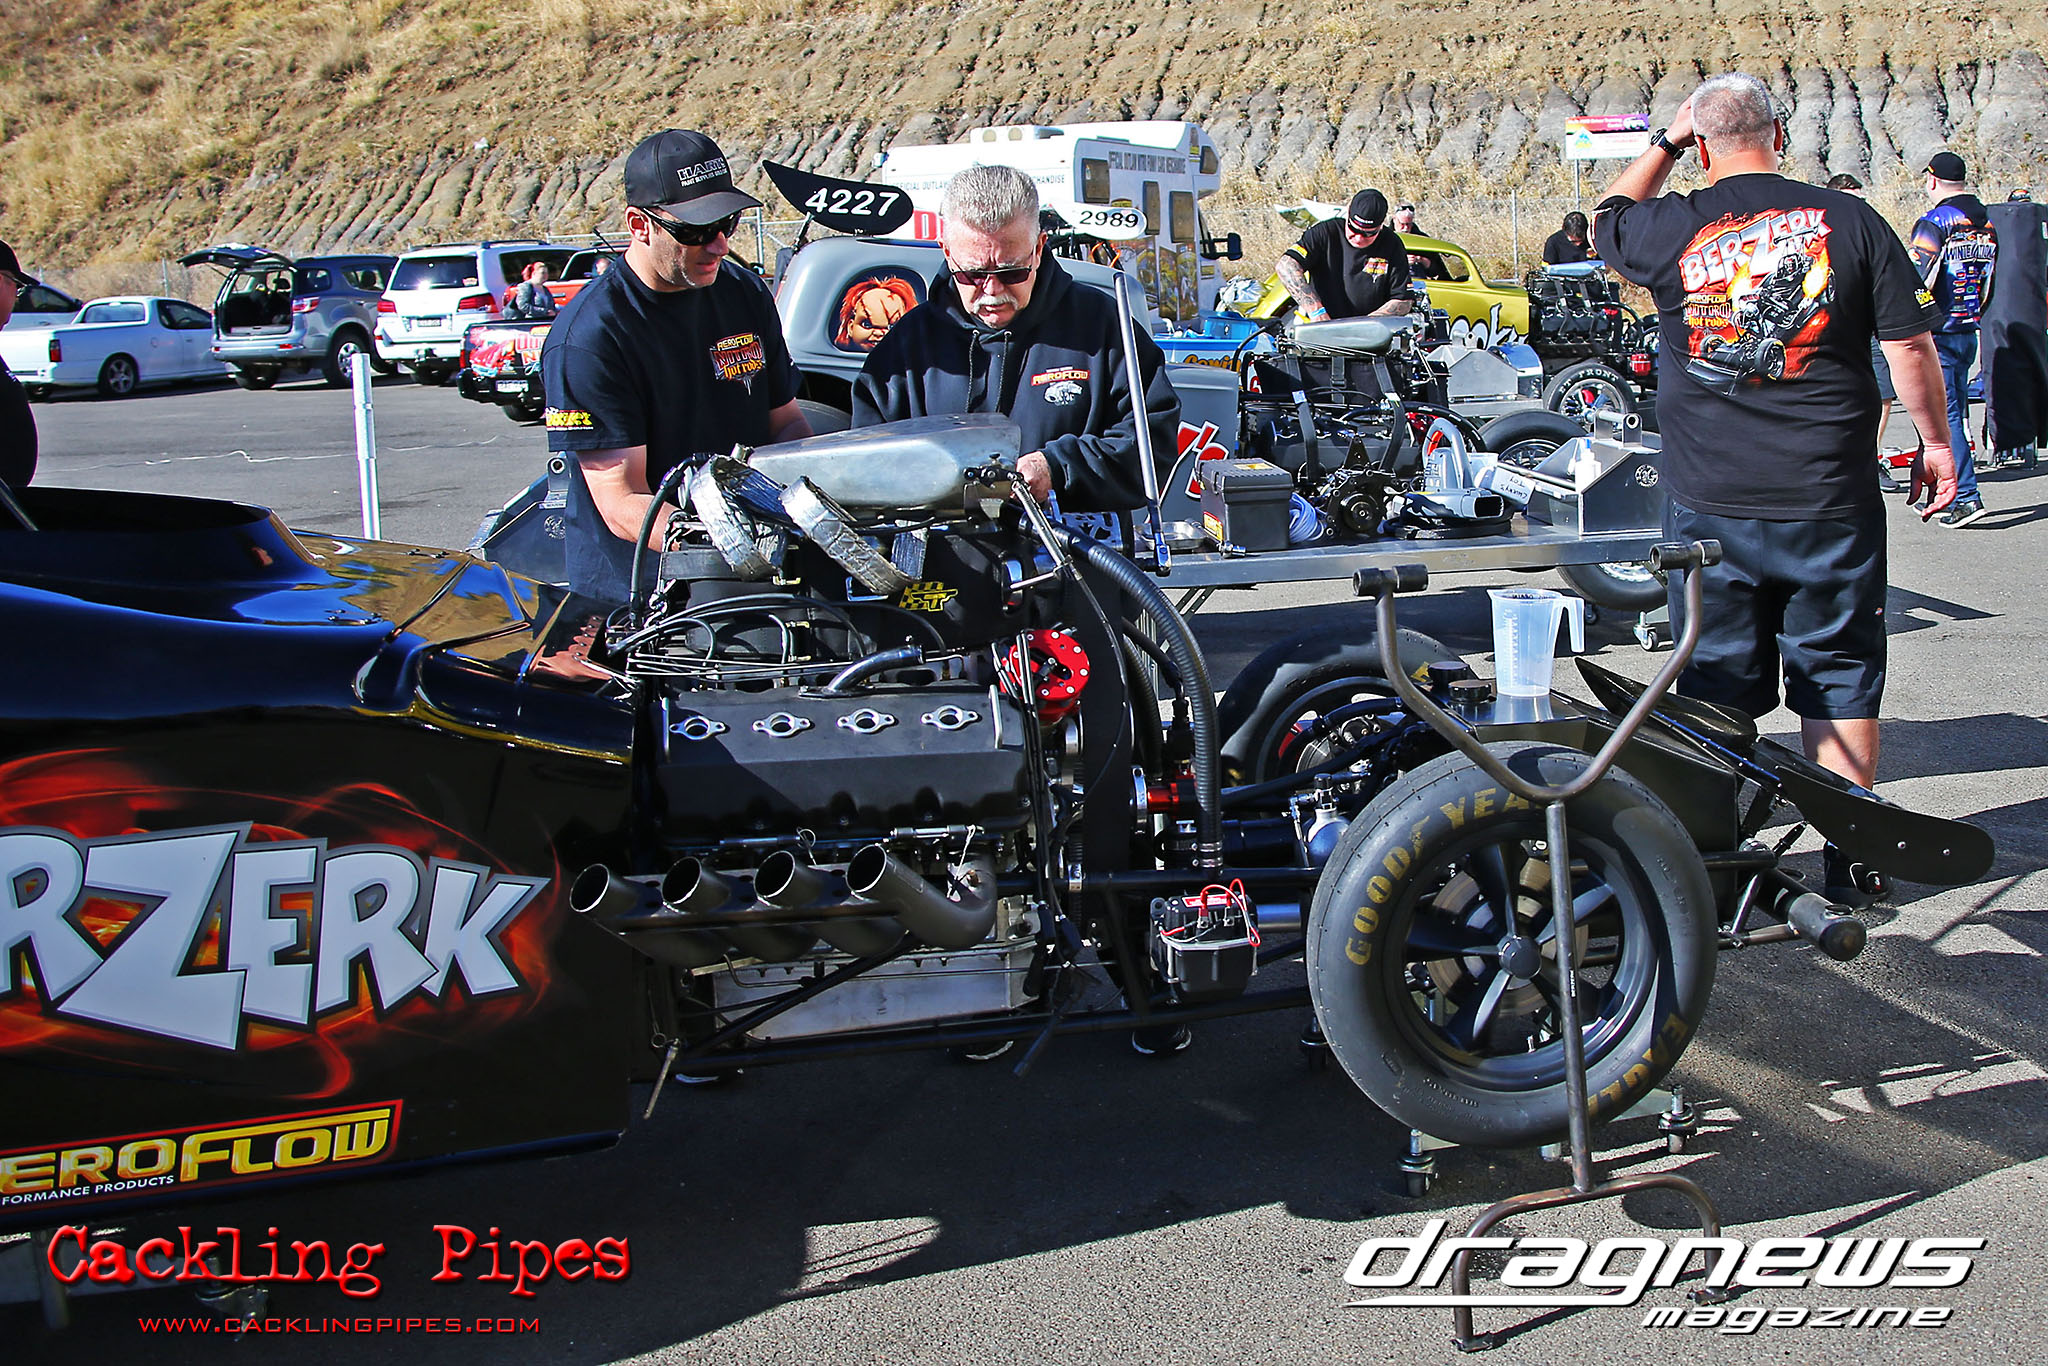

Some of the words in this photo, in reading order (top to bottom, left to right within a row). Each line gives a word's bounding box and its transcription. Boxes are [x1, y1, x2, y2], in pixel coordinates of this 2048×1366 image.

[805, 187, 900, 217] 4227
[1079, 210, 1138, 228] 2989
[1681, 210, 1831, 291] BERZERK
[1578, 368, 1619, 382] FRONT
[1344, 845, 1412, 966] GOOD
[1438, 786, 1545, 830] YEA
[0, 823, 547, 1052] RZERK
[1588, 1012, 1690, 1117] EAGL
[0, 1108, 391, 1194] EROFLOW
[94, 1175, 174, 1194] PRODUCTS
